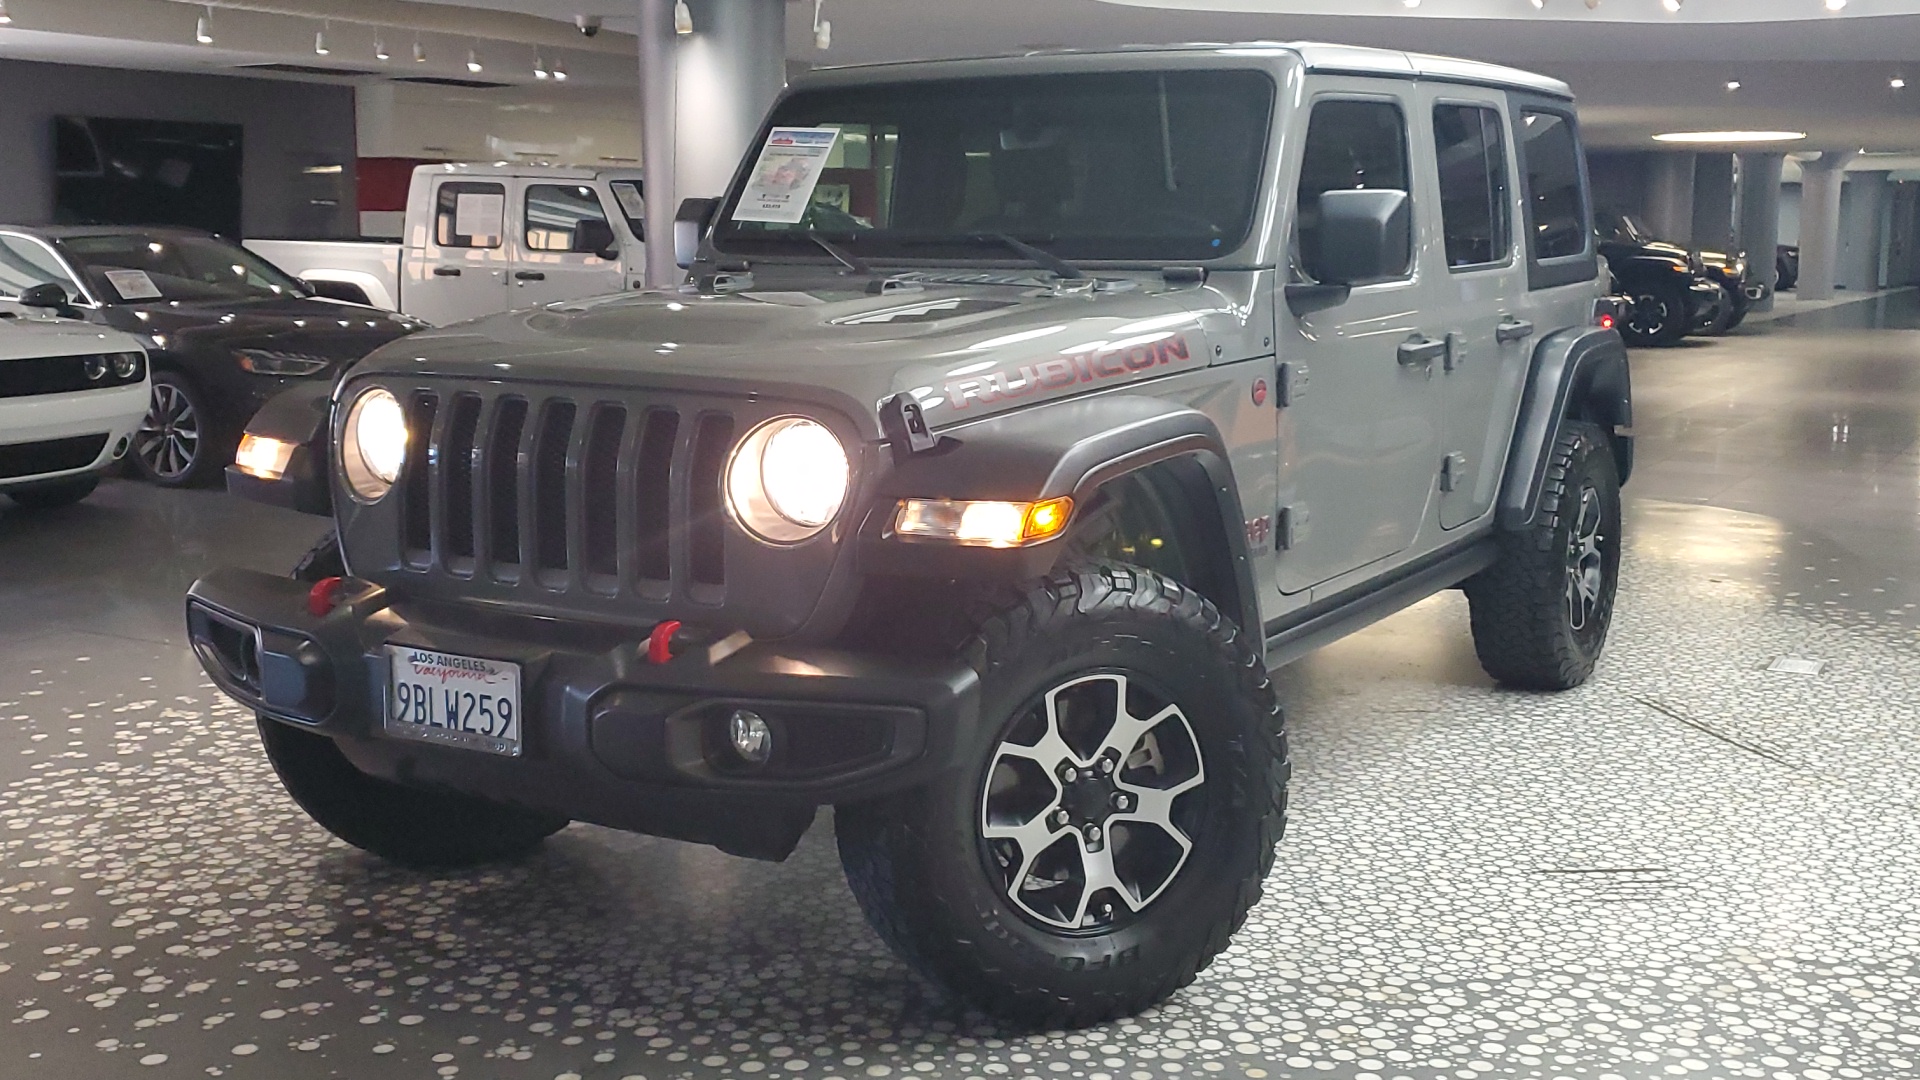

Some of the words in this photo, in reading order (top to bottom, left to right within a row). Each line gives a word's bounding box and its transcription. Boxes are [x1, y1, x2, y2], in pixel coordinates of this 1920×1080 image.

[944, 335, 1191, 410] RUBICON
[413, 651, 434, 664] LOS
[436, 655, 486, 671] ANGELES
[397, 682, 512, 738] 9BLW259
